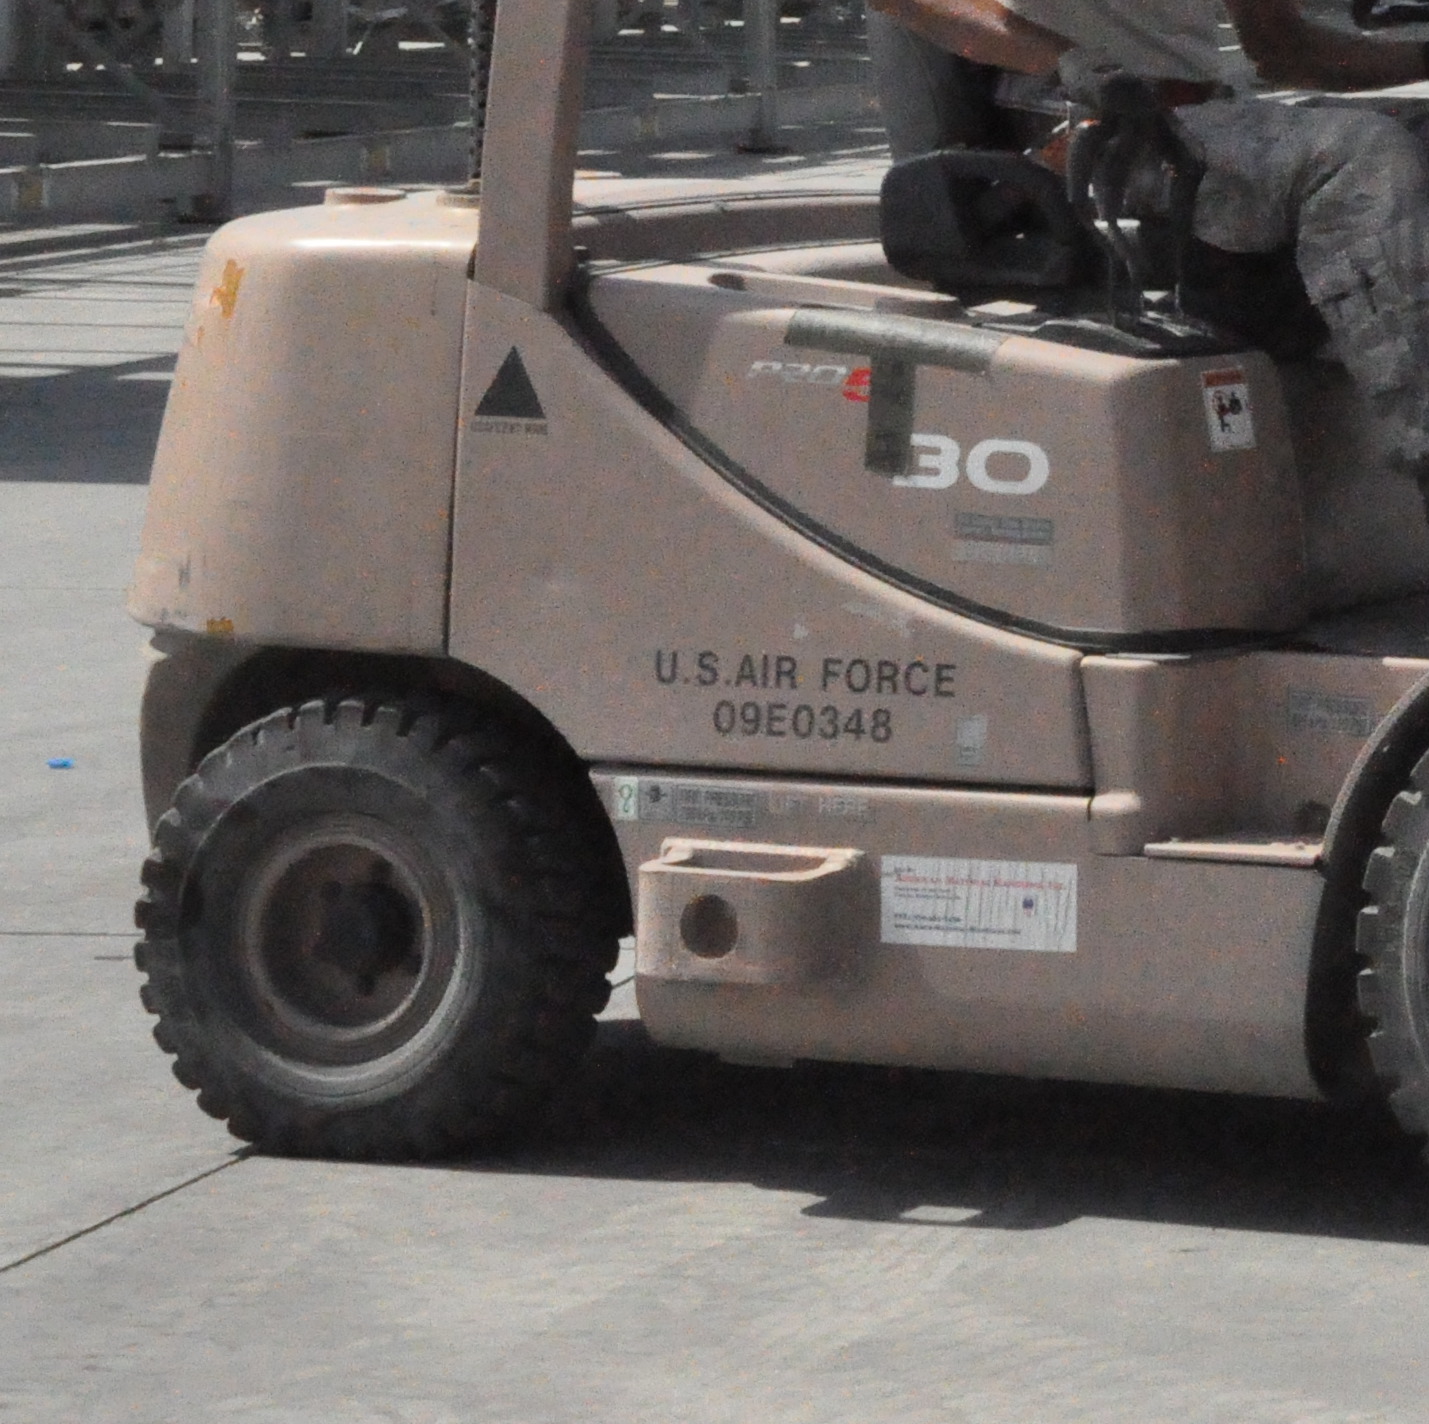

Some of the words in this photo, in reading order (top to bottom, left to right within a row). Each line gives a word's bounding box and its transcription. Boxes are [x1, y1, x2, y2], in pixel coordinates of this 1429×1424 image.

[892, 433, 1049, 494] 30
[821, 658, 956, 698] FORCE
[713, 699, 892, 744] 09E0348
